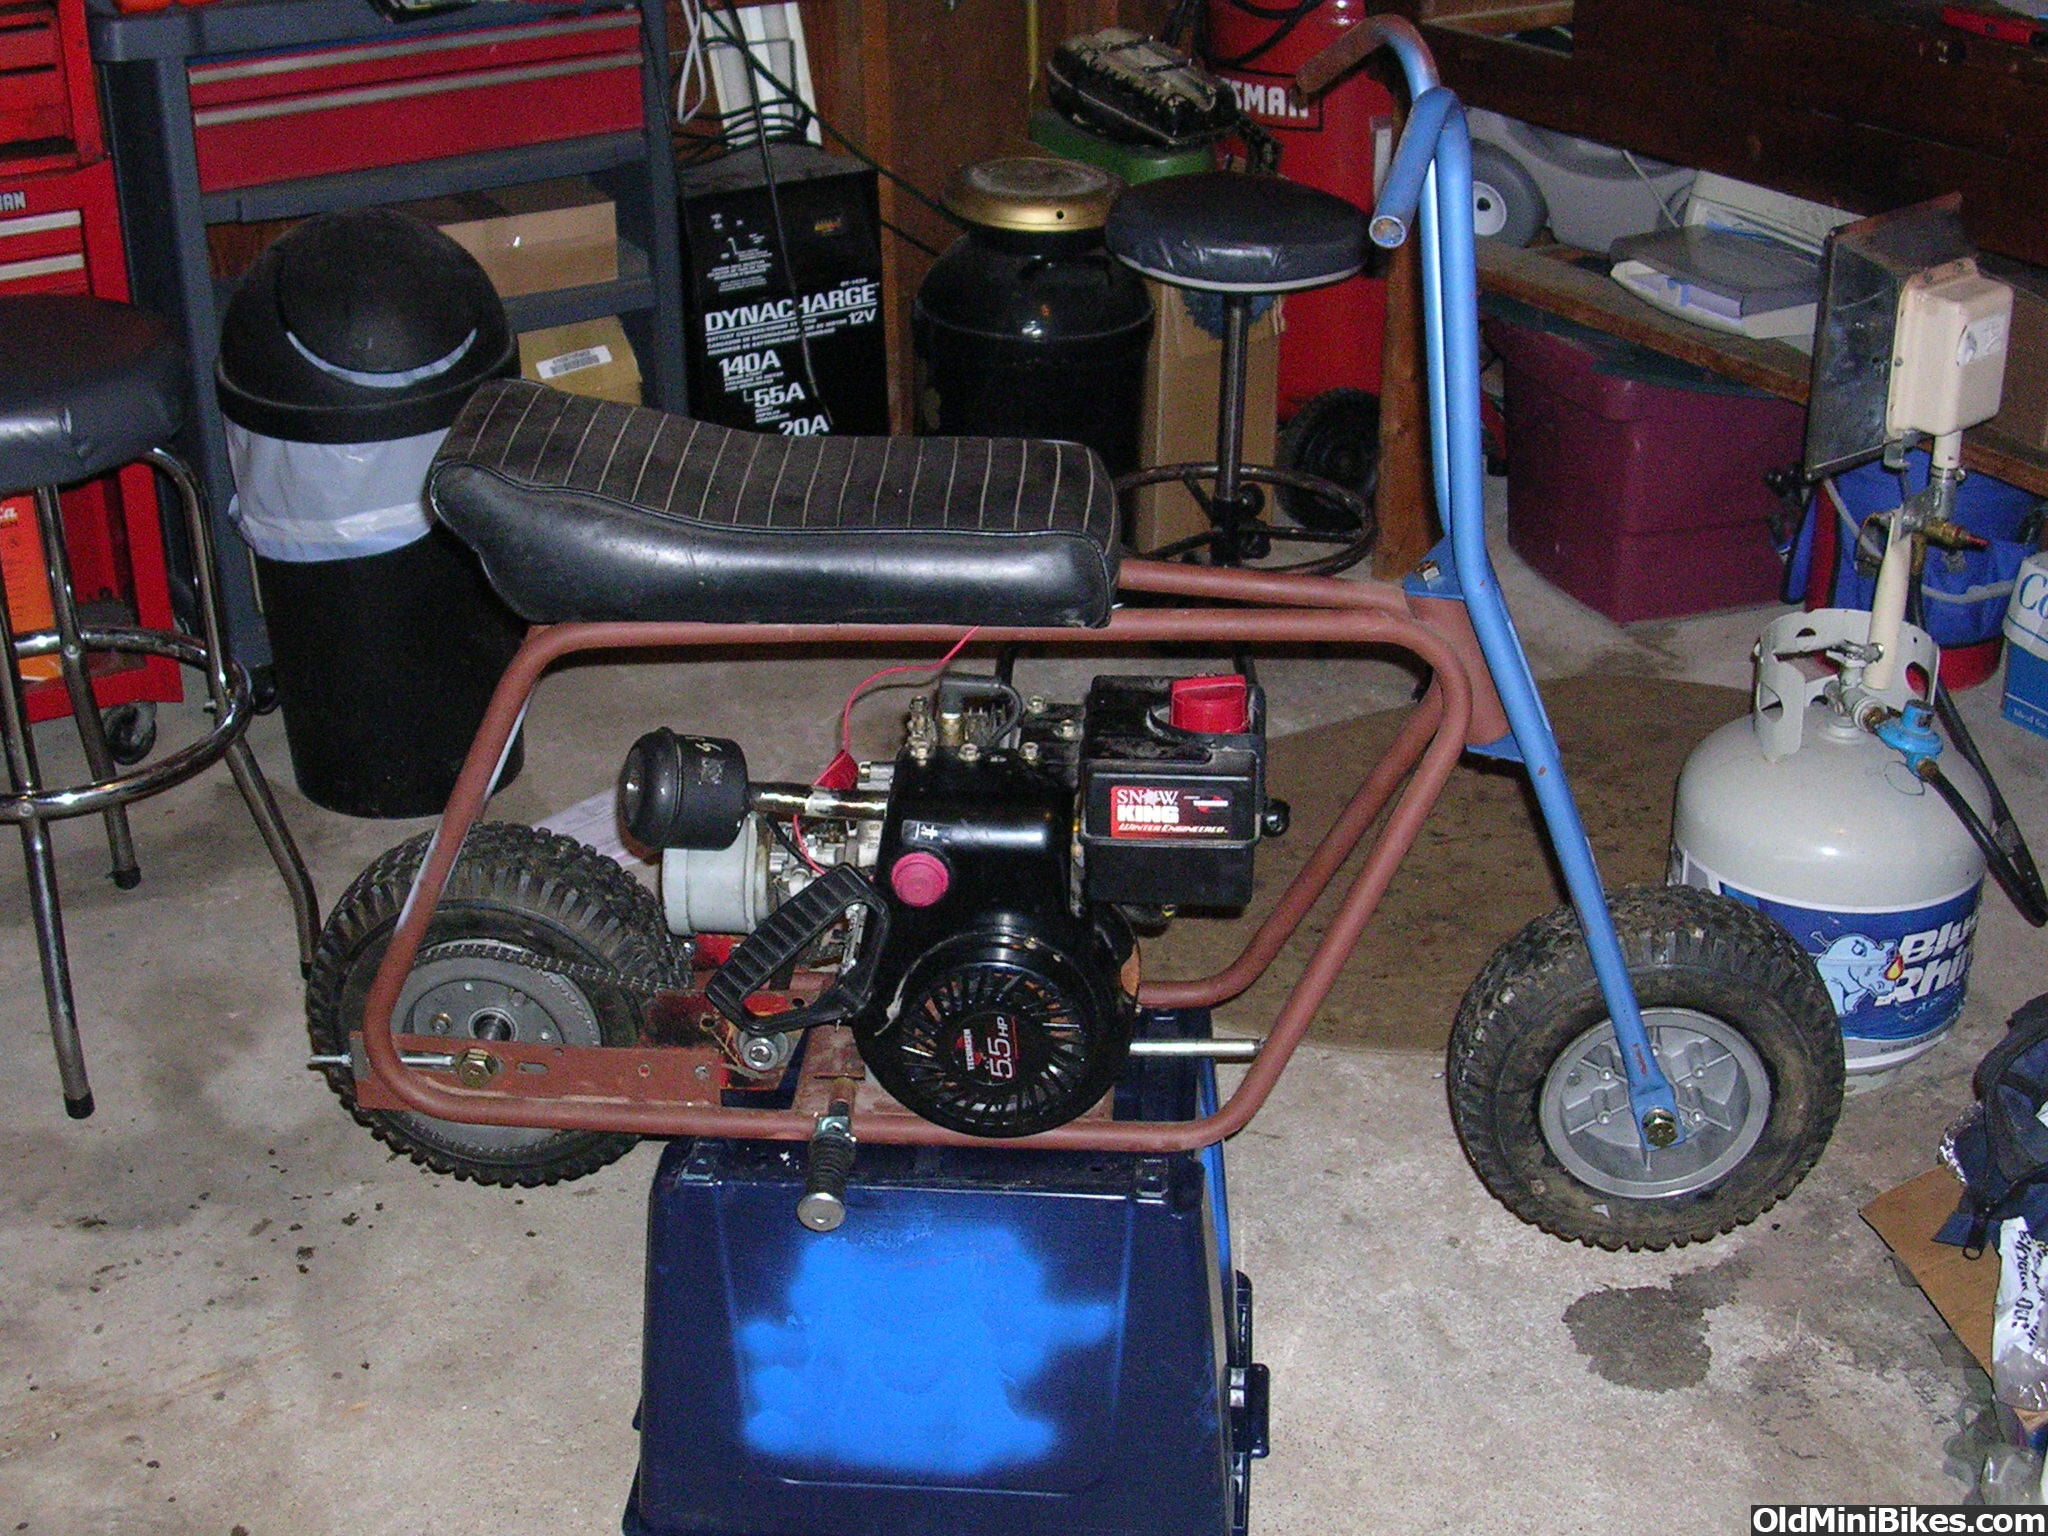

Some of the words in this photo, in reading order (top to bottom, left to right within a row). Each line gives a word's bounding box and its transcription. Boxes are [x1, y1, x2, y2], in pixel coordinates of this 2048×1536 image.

[0, 191, 26, 211] AN
[848, 308, 877, 326] 12V
[719, 349, 781, 377] 140A
[754, 382, 806, 408] 55A
[778, 414, 830, 436] 20A
[1117, 805, 1180, 823] KING
[996, 1016, 1009, 1037] HP
